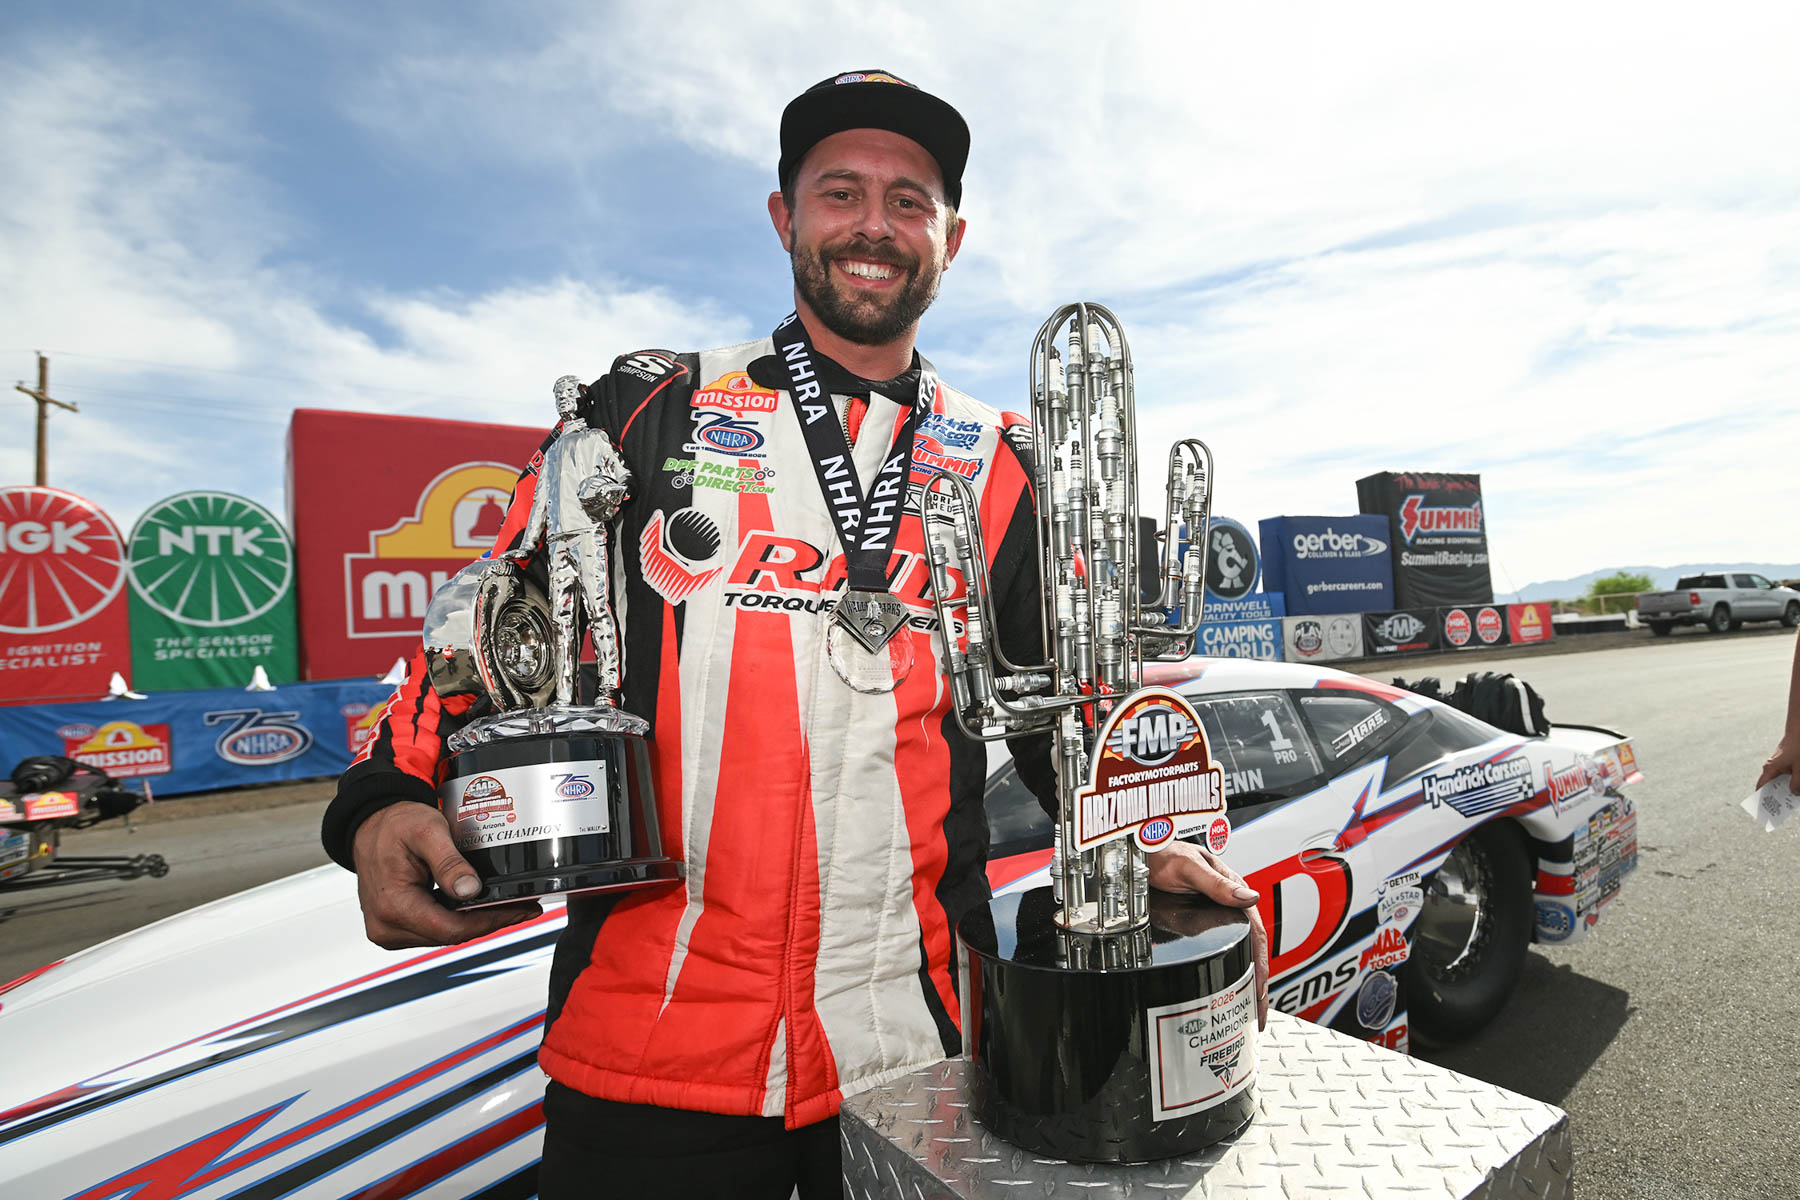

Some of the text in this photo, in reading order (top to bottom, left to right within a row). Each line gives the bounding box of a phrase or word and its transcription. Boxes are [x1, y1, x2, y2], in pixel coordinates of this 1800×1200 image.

[617, 365, 658, 384] SIMPSON
[782, 341, 828, 426] NHRA
[709, 429, 750, 448] NHRA
[663, 457, 756, 480] DPF PARTS
[693, 475, 776, 494] DIRECT.COM
[819, 454, 864, 544] NHR
[860, 452, 906, 551] NHRA
[932, 493, 951, 504] DRI
[933, 502, 953, 513] MED
[158, 525, 265, 557] NTK
[1293, 528, 1364, 559] gerber
[1307, 551, 1338, 559] COLLISION
[1344, 550, 1362, 558] GLASS
[1306, 581, 1384, 595] gerbercareers.com
[723, 592, 838, 616] TORQUE
[1240, 610, 1272, 619] TOOLS
[1202, 624, 1275, 646] CAMPING
[1294, 626, 1322, 643] PLAY
[1384, 618, 1420, 639] FMP
[6, 641, 103, 656] IGNITION
[153, 634, 274, 648] THE SENSOR
[1204, 641, 1276, 660] WORLD
[153, 645, 272, 661] SPECIALIST
[1121, 713, 1188, 760] FMP
[1261, 710, 1294, 750] 1
[1349, 712, 1385, 745] HAAS
[235, 735, 290, 755] NHRA
[1273, 749, 1298, 764] PRO
[1108, 761, 1199, 788] FACTORYMOTORPARTS
[1224, 768, 1265, 796] ENN
[563, 783, 588, 796] NHRA
[1082, 770, 1220, 841] ARIZONA NATIONALS
[482, 822, 506, 831] Arizona
[497, 823, 562, 841] CHAMPION
[1142, 821, 1170, 841] NHRA
[1177, 825, 1201, 835] PRESENTED
[1211, 823, 1226, 834] NGK
[1389, 872, 1420, 888] GETTRX
[1381, 897, 1395, 912] ALL
[1399, 891, 1421, 901] STAR
[1370, 950, 1407, 970] TOOLS
[1210, 990, 1235, 1010] 2026
[1183, 995, 1252, 1035] FMP NATIONAL
[1188, 1012, 1249, 1049] CHAMPIONS
[1200, 1036, 1246, 1067] FIREBIRD
